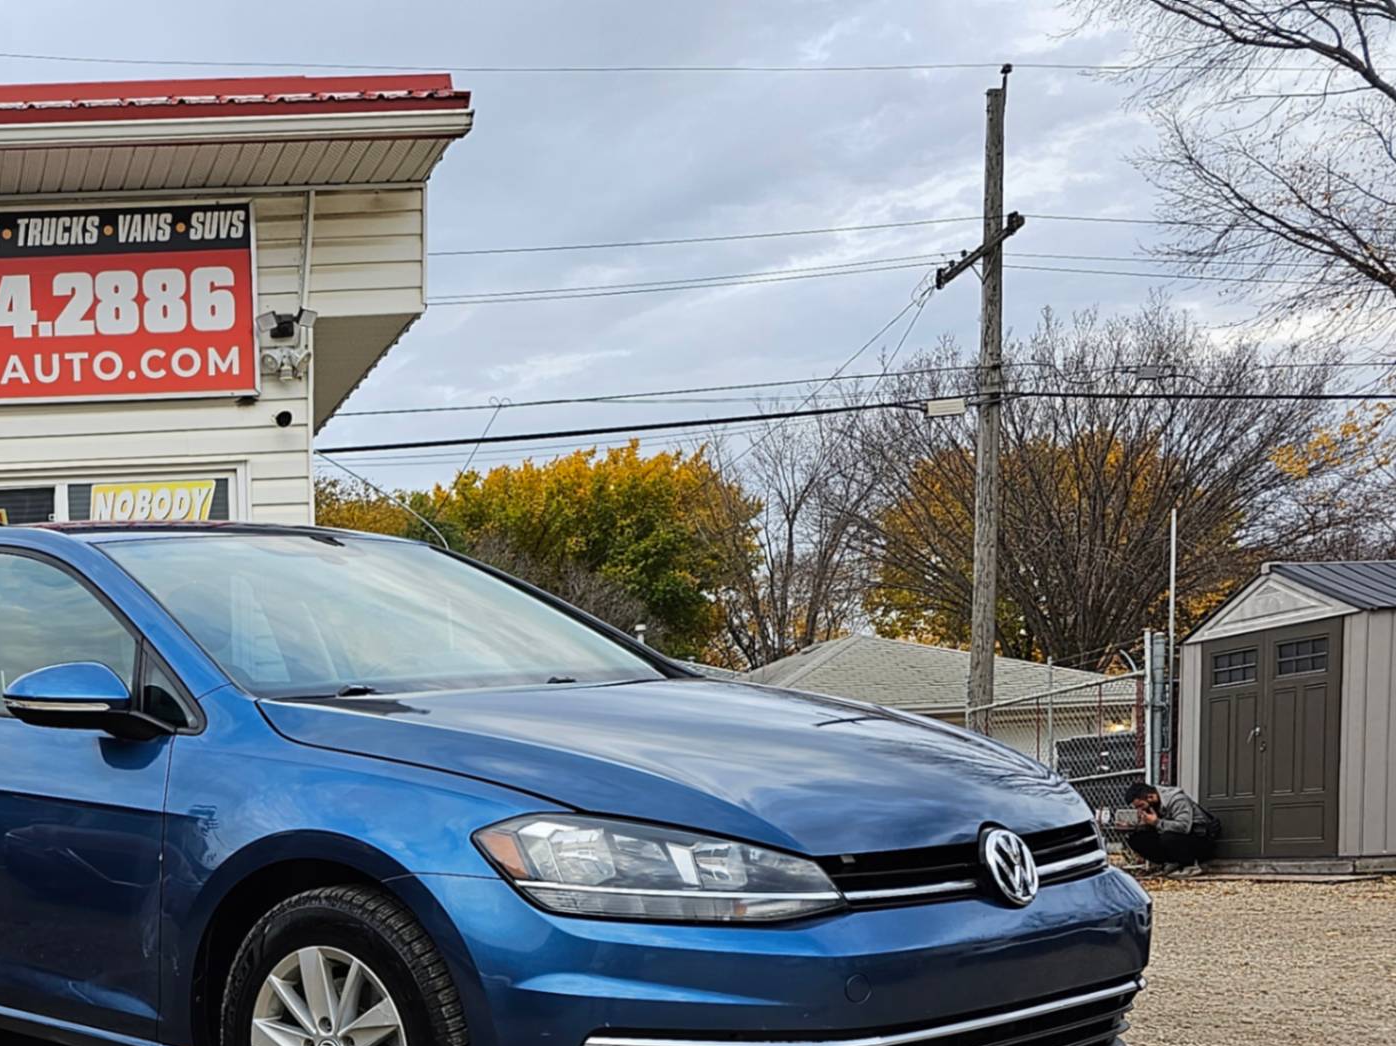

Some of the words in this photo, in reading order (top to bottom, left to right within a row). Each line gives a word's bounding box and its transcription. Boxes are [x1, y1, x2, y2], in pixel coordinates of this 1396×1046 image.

[15, 215, 100, 246] TRUCKS
[116, 212, 173, 243] VANS
[188, 209, 246, 240] SUVS
[94, 488, 211, 521] NOBODY
